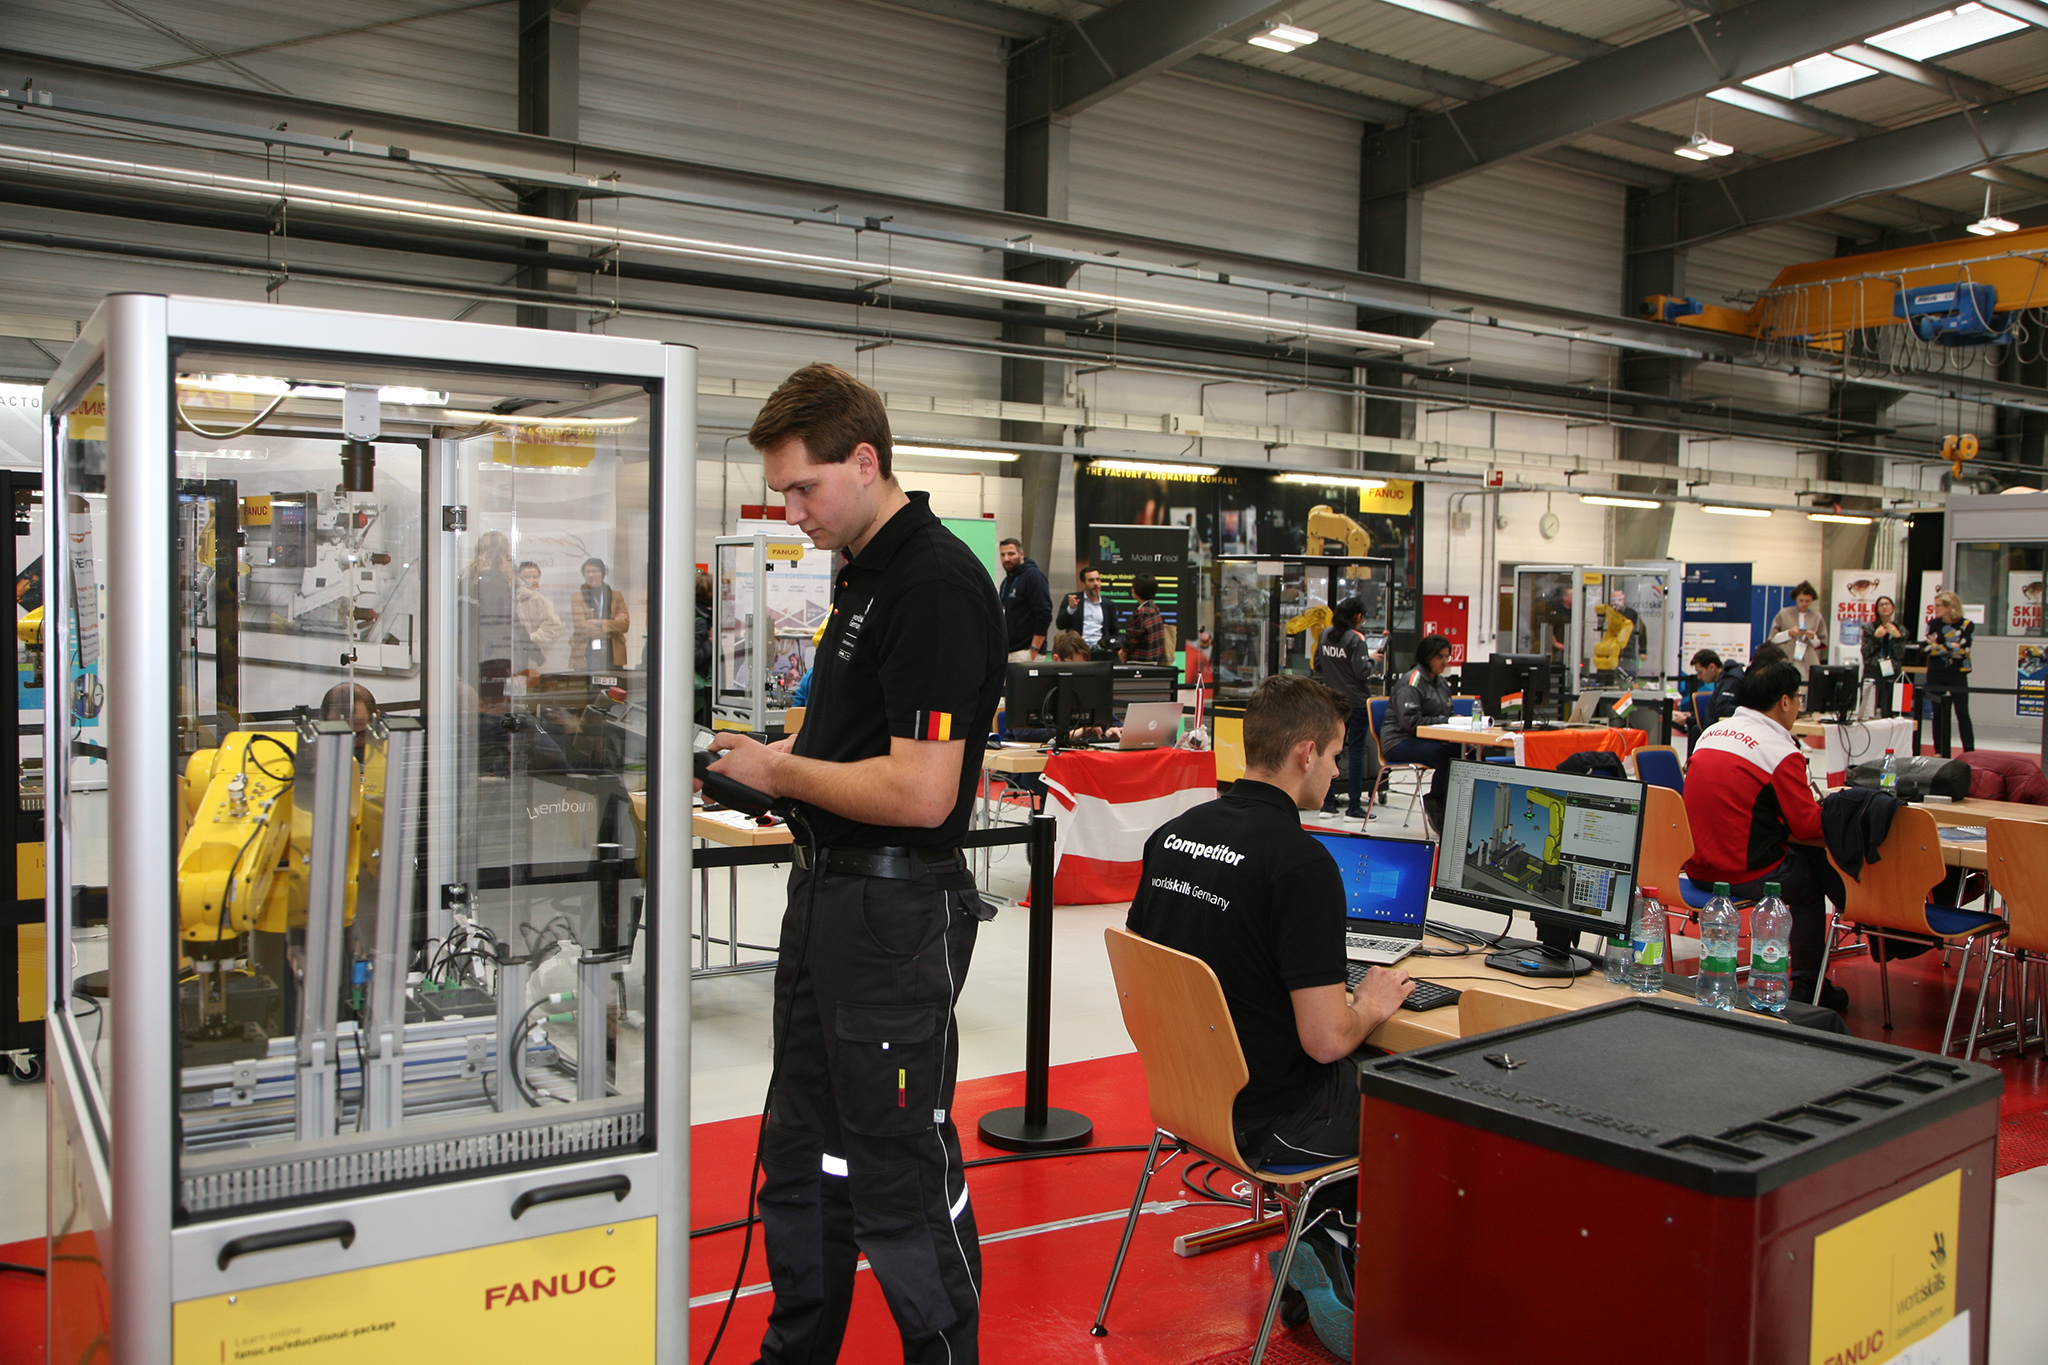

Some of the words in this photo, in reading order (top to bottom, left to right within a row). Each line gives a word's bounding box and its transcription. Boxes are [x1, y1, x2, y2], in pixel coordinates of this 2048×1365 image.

[0, 396, 40, 408] ACTO
[1086, 467, 1102, 476] THE
[1105, 468, 1143, 479] FACTORY
[1145, 472, 1198, 483] AUTOMATION
[1200, 475, 1238, 485] COMPANY
[1369, 488, 1404, 500] FANUC
[244, 506, 268, 516] FANUC
[1131, 553, 1153, 562] Make
[1154, 554, 1162, 562] IT
[1162, 553, 1179, 562] real
[1322, 645, 1347, 658] INDIA
[1163, 833, 1245, 866] Competitor
[1191, 885, 1230, 912] Germany
[485, 1265, 616, 1310] FANUC
[1896, 1272, 1946, 1316] worldskills
[234, 1320, 396, 1360] fanuc.eu/educational-package
[1823, 1329, 1884, 1365] FANUC
